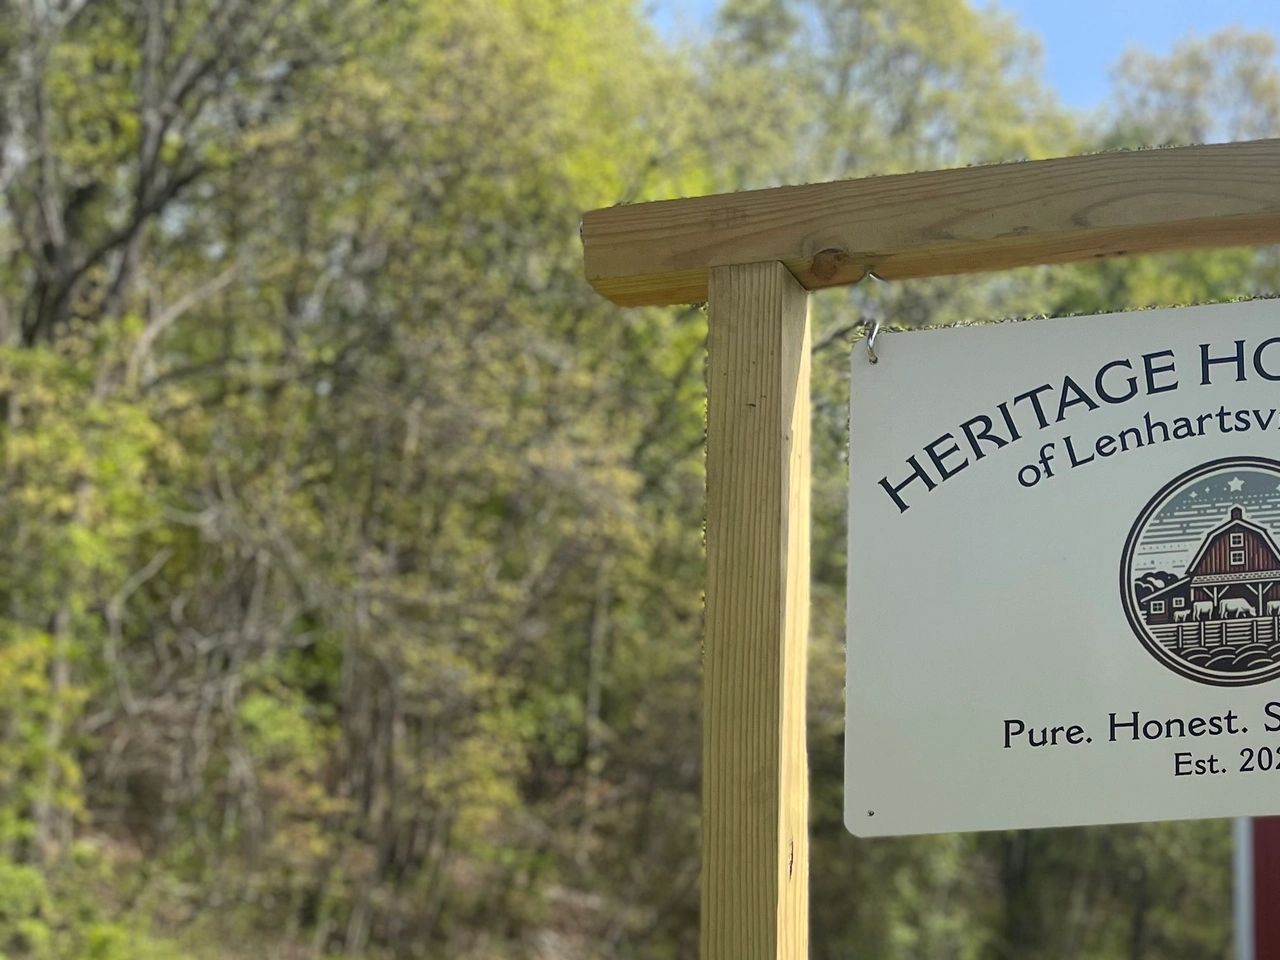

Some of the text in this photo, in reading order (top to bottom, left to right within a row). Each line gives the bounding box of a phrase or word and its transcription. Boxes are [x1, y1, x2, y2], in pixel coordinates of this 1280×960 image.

[877, 349, 1179, 515] HERITAGE
[1017, 442, 1056, 488] of
[1003, 719, 1093, 749] Pure.
[1108, 709, 1249, 742] Honest.
[1174, 751, 1227, 777] Est.
